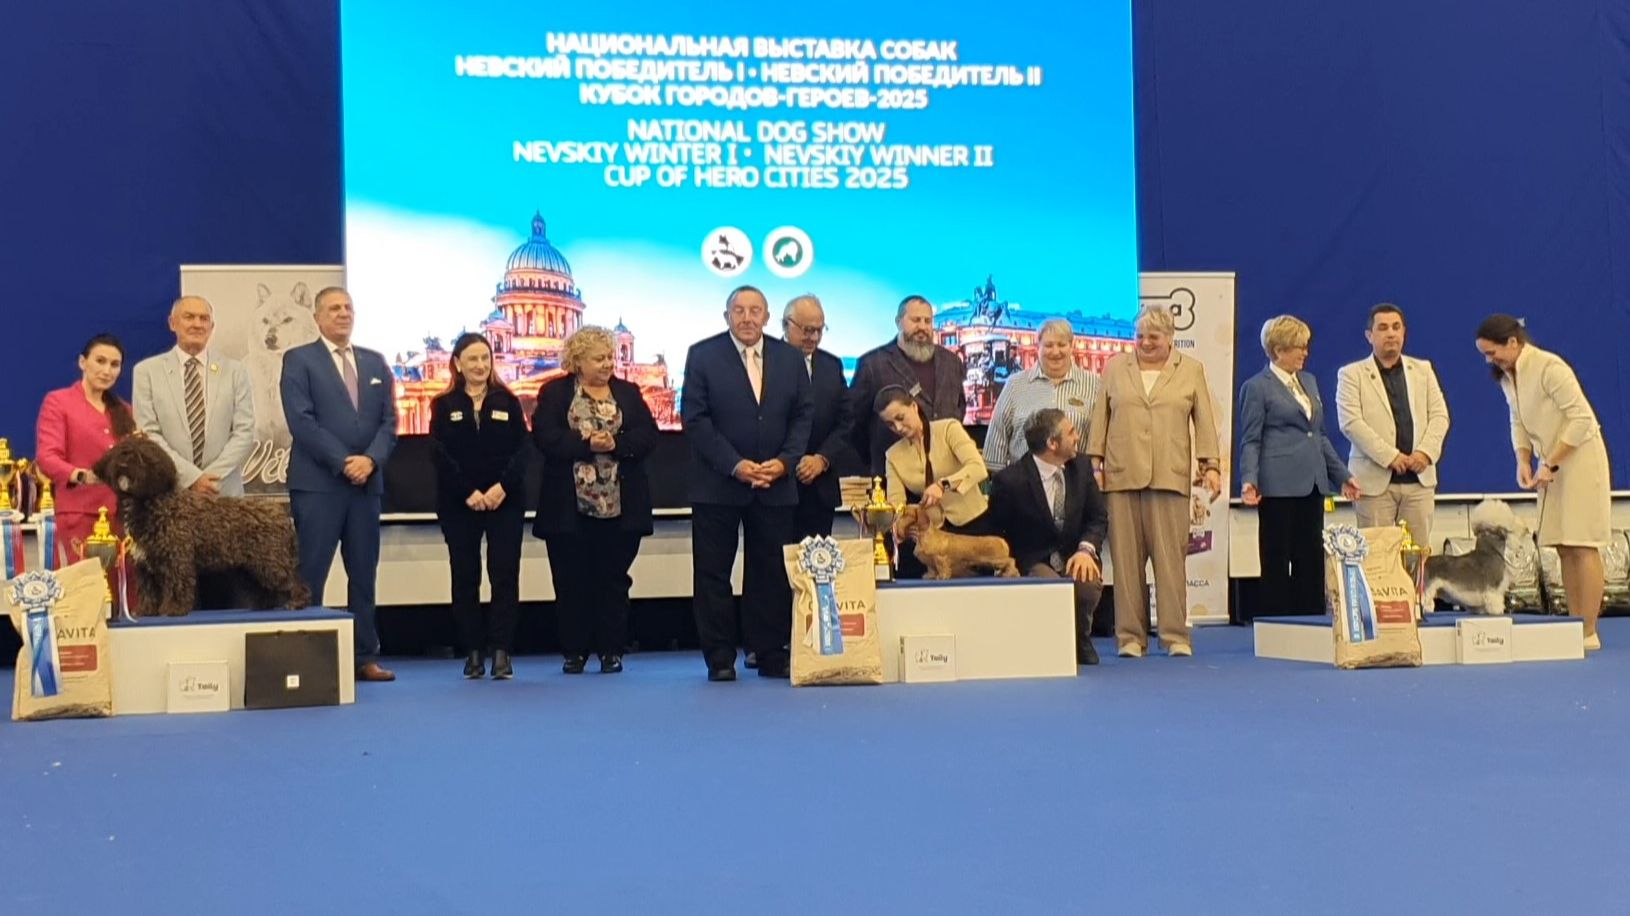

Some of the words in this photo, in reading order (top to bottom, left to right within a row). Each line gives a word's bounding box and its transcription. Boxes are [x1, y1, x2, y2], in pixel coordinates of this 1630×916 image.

[546, 32, 748, 58] НАЦИОНАЛЬНАЯ
[753, 37, 876, 60] ВЫСТАВКА
[880, 40, 957, 61] СОБАК
[455, 54, 570, 78] НЕВСКИЙ
[575, 57, 733, 84] ПОБЕДИТЕЛЬ
[760, 60, 869, 84] НЕВСКИЙ
[873, 63, 1023, 88] ПОБЕДИТЕЛЬ
[579, 83, 662, 105] КУБОК
[665, 85, 928, 110] ГОРОДОВ-ГЕРОЕВ-2025
[628, 118, 751, 142] NATIONAL
[757, 121, 807, 143] DOG
[811, 121, 886, 144] SHOW
[512, 141, 618, 163] NEVSKIY
[623, 142, 721, 165] WINTER
[764, 144, 865, 165] NEVSKIY
[869, 145, 969, 167] WINNER
[974, 145, 993, 167] II
[604, 165, 651, 187] CUP
[656, 166, 687, 187] OF
[694, 165, 759, 188] HERO
[763, 166, 839, 188] CITIES
[844, 167, 909, 189] 2025
